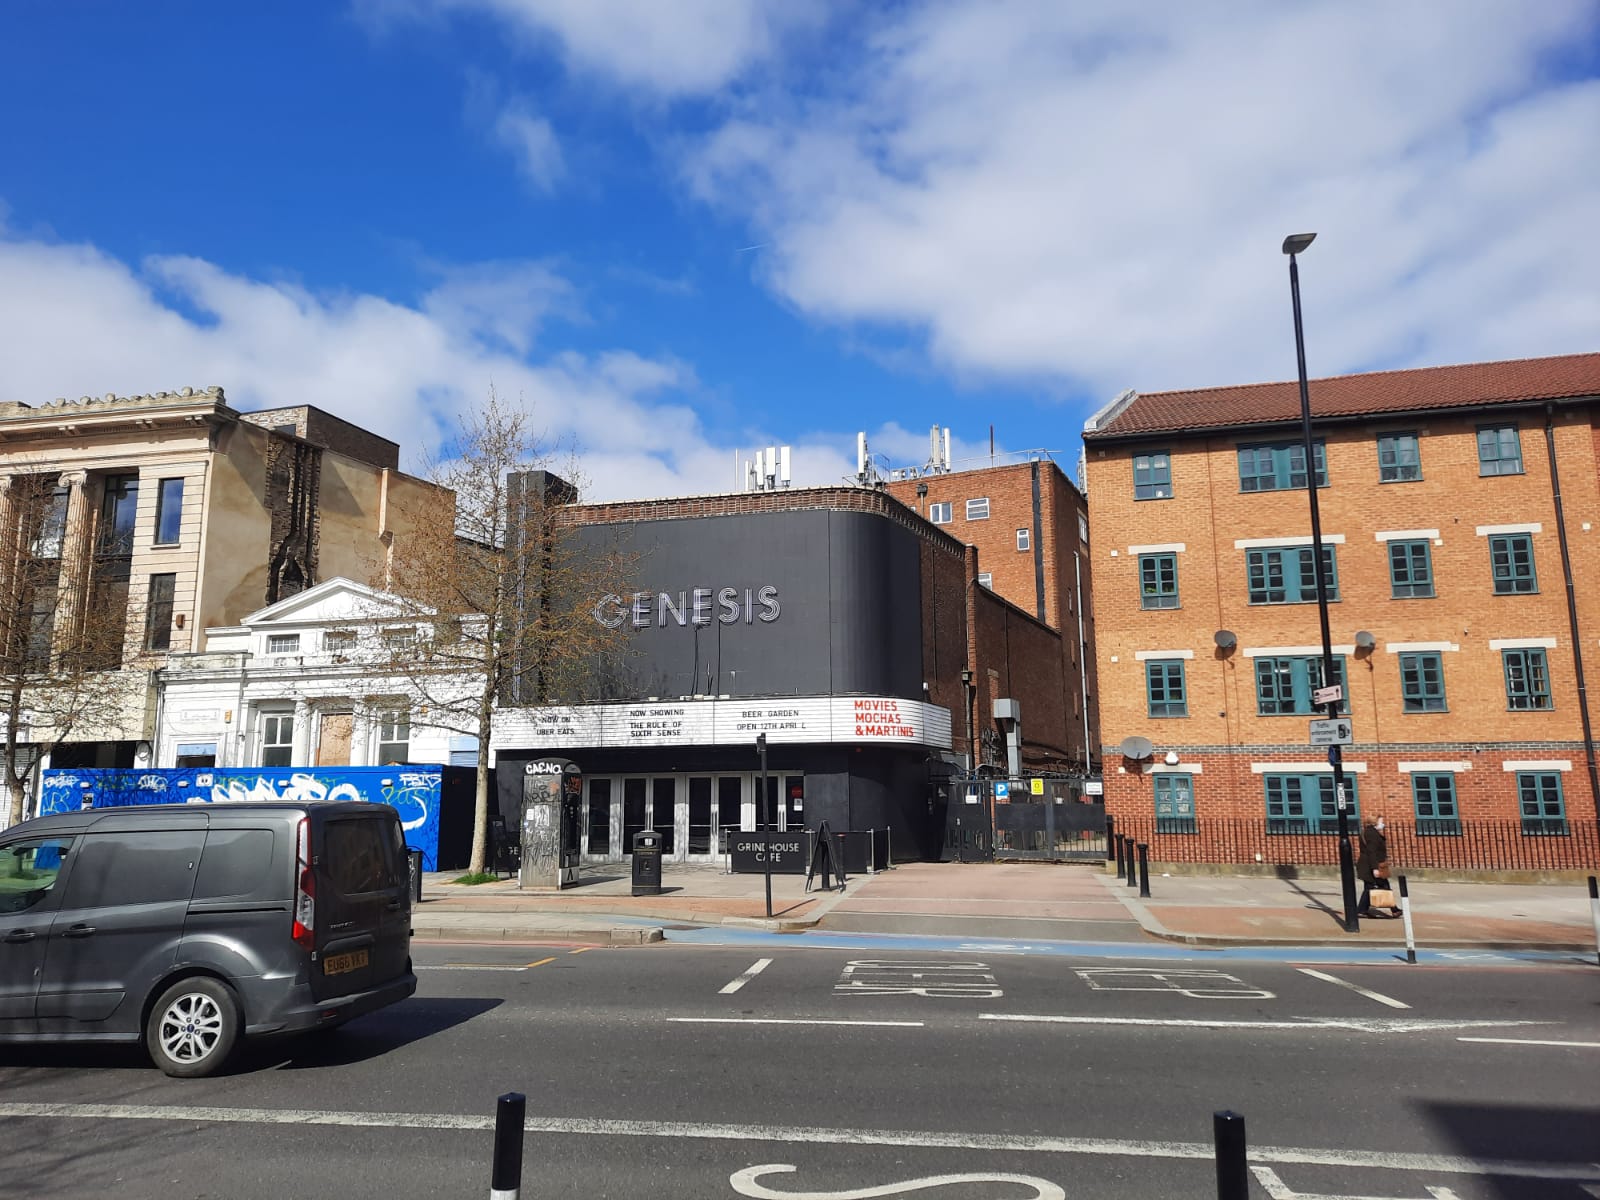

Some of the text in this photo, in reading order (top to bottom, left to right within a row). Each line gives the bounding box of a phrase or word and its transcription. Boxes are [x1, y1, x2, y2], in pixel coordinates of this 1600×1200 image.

[593, 585, 781, 629] GENESIS
[854, 700, 898, 711] MOVIES
[650, 708, 685, 716] SHOWING
[742, 709, 799, 718] BEER GARDEN
[855, 712, 902, 724] MOCHAS
[647, 721, 667, 729] RULE
[672, 720, 683, 728] OF
[736, 723, 757, 731] OPEN
[761, 722, 778, 730] 12TH
[537, 728, 575, 736] UBER EATS
[630, 729, 681, 738] SIXTH SENSE
[755, 852, 782, 863] CFE
[832, 960, 1004, 998] CLEAR
